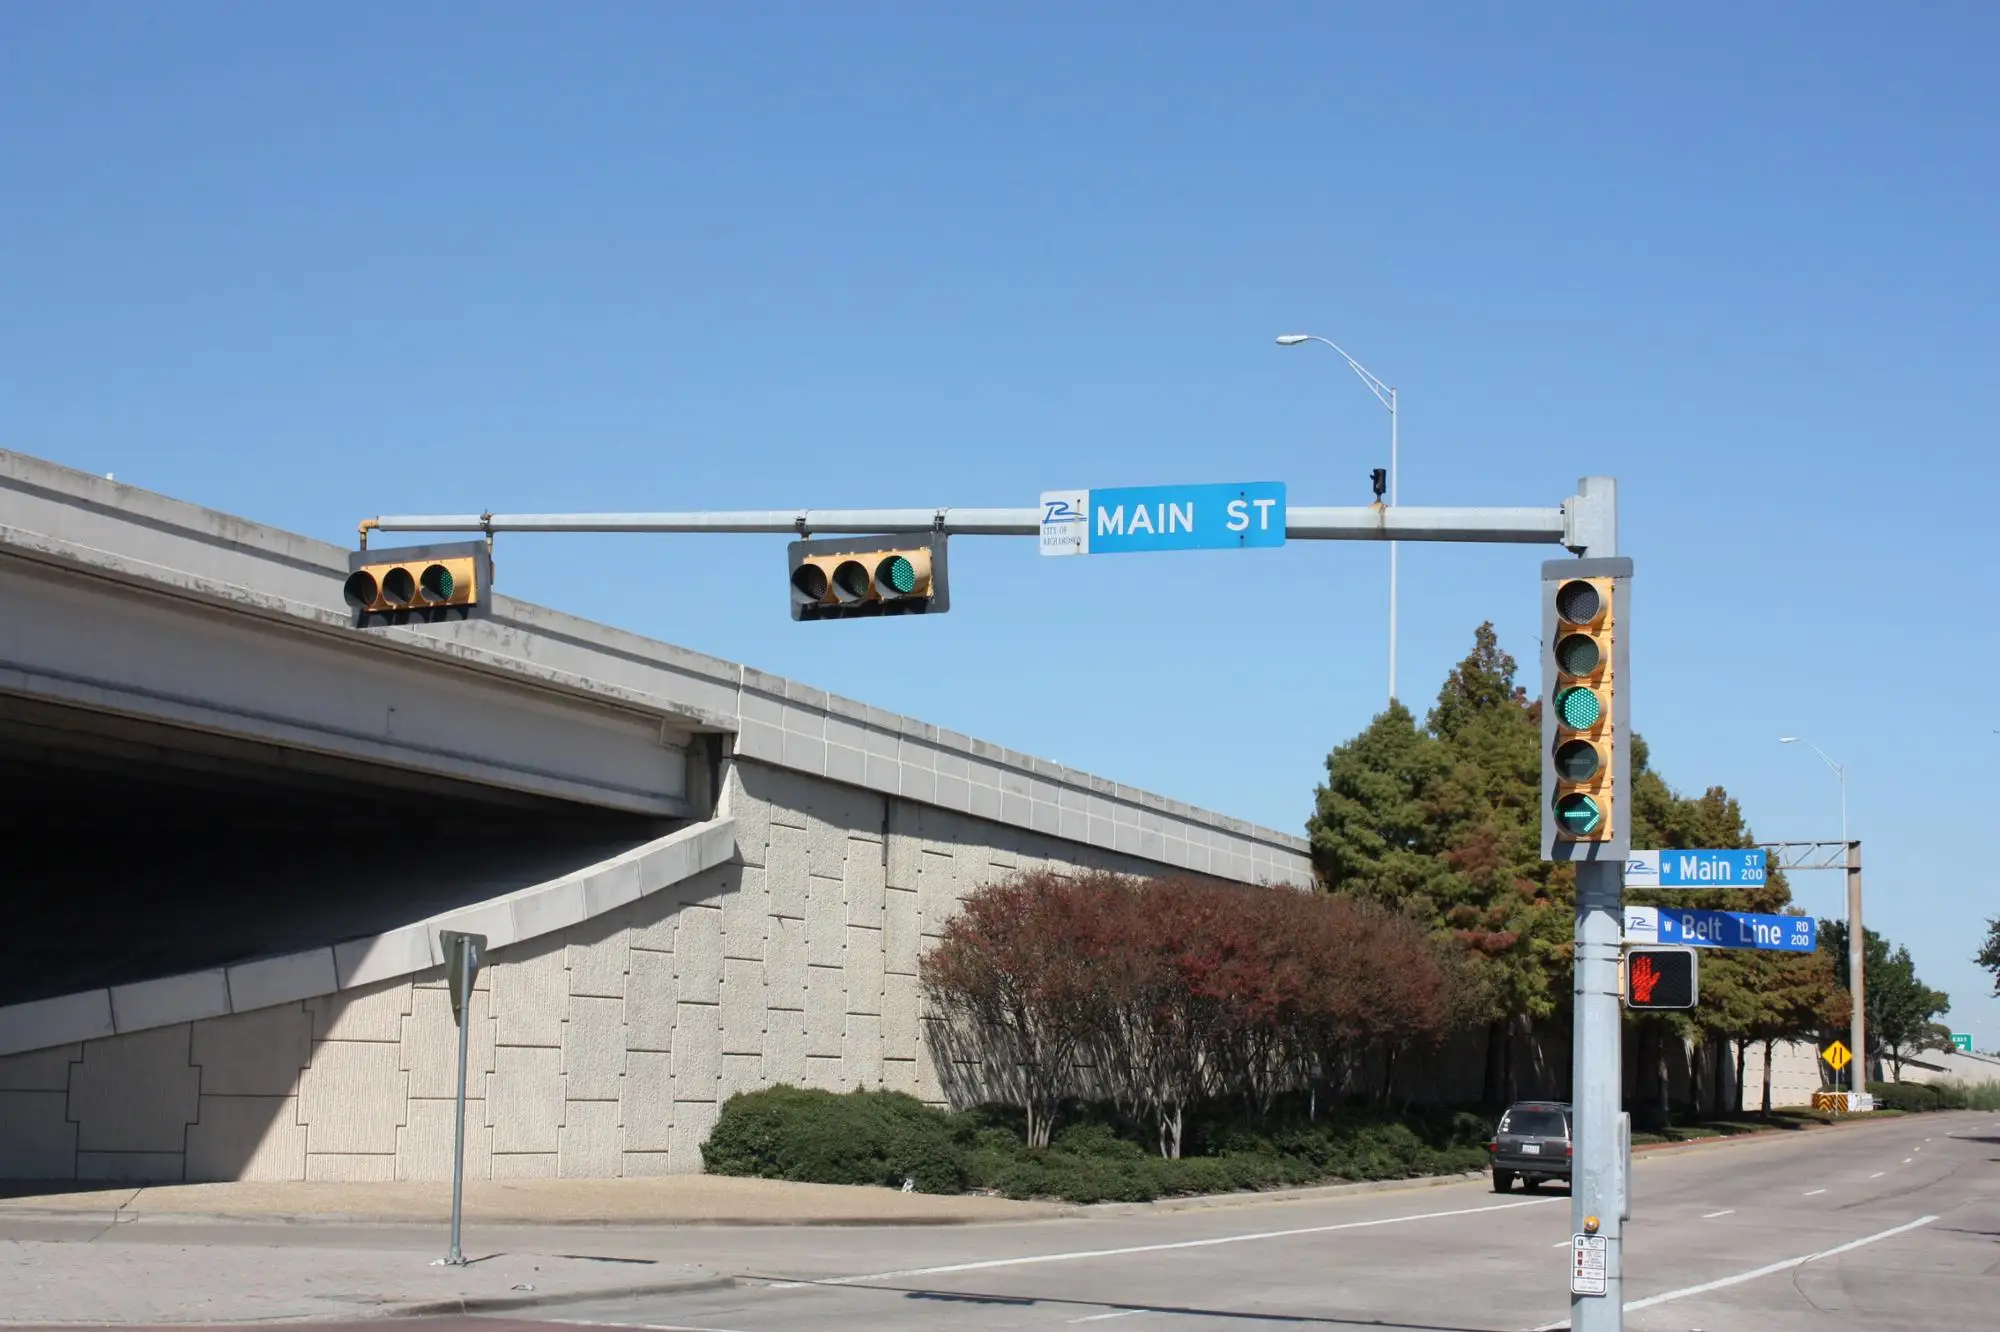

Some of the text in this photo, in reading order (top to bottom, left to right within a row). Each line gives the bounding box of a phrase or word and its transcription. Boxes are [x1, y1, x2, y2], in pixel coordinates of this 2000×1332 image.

[1097, 499, 1276, 536] MAIN ST
[1662, 855, 1759, 881] W Main ST
[1741, 868, 1763, 880] 200
[1664, 914, 1809, 945] W Belt Line RD
[1791, 934, 1809, 946] 200
